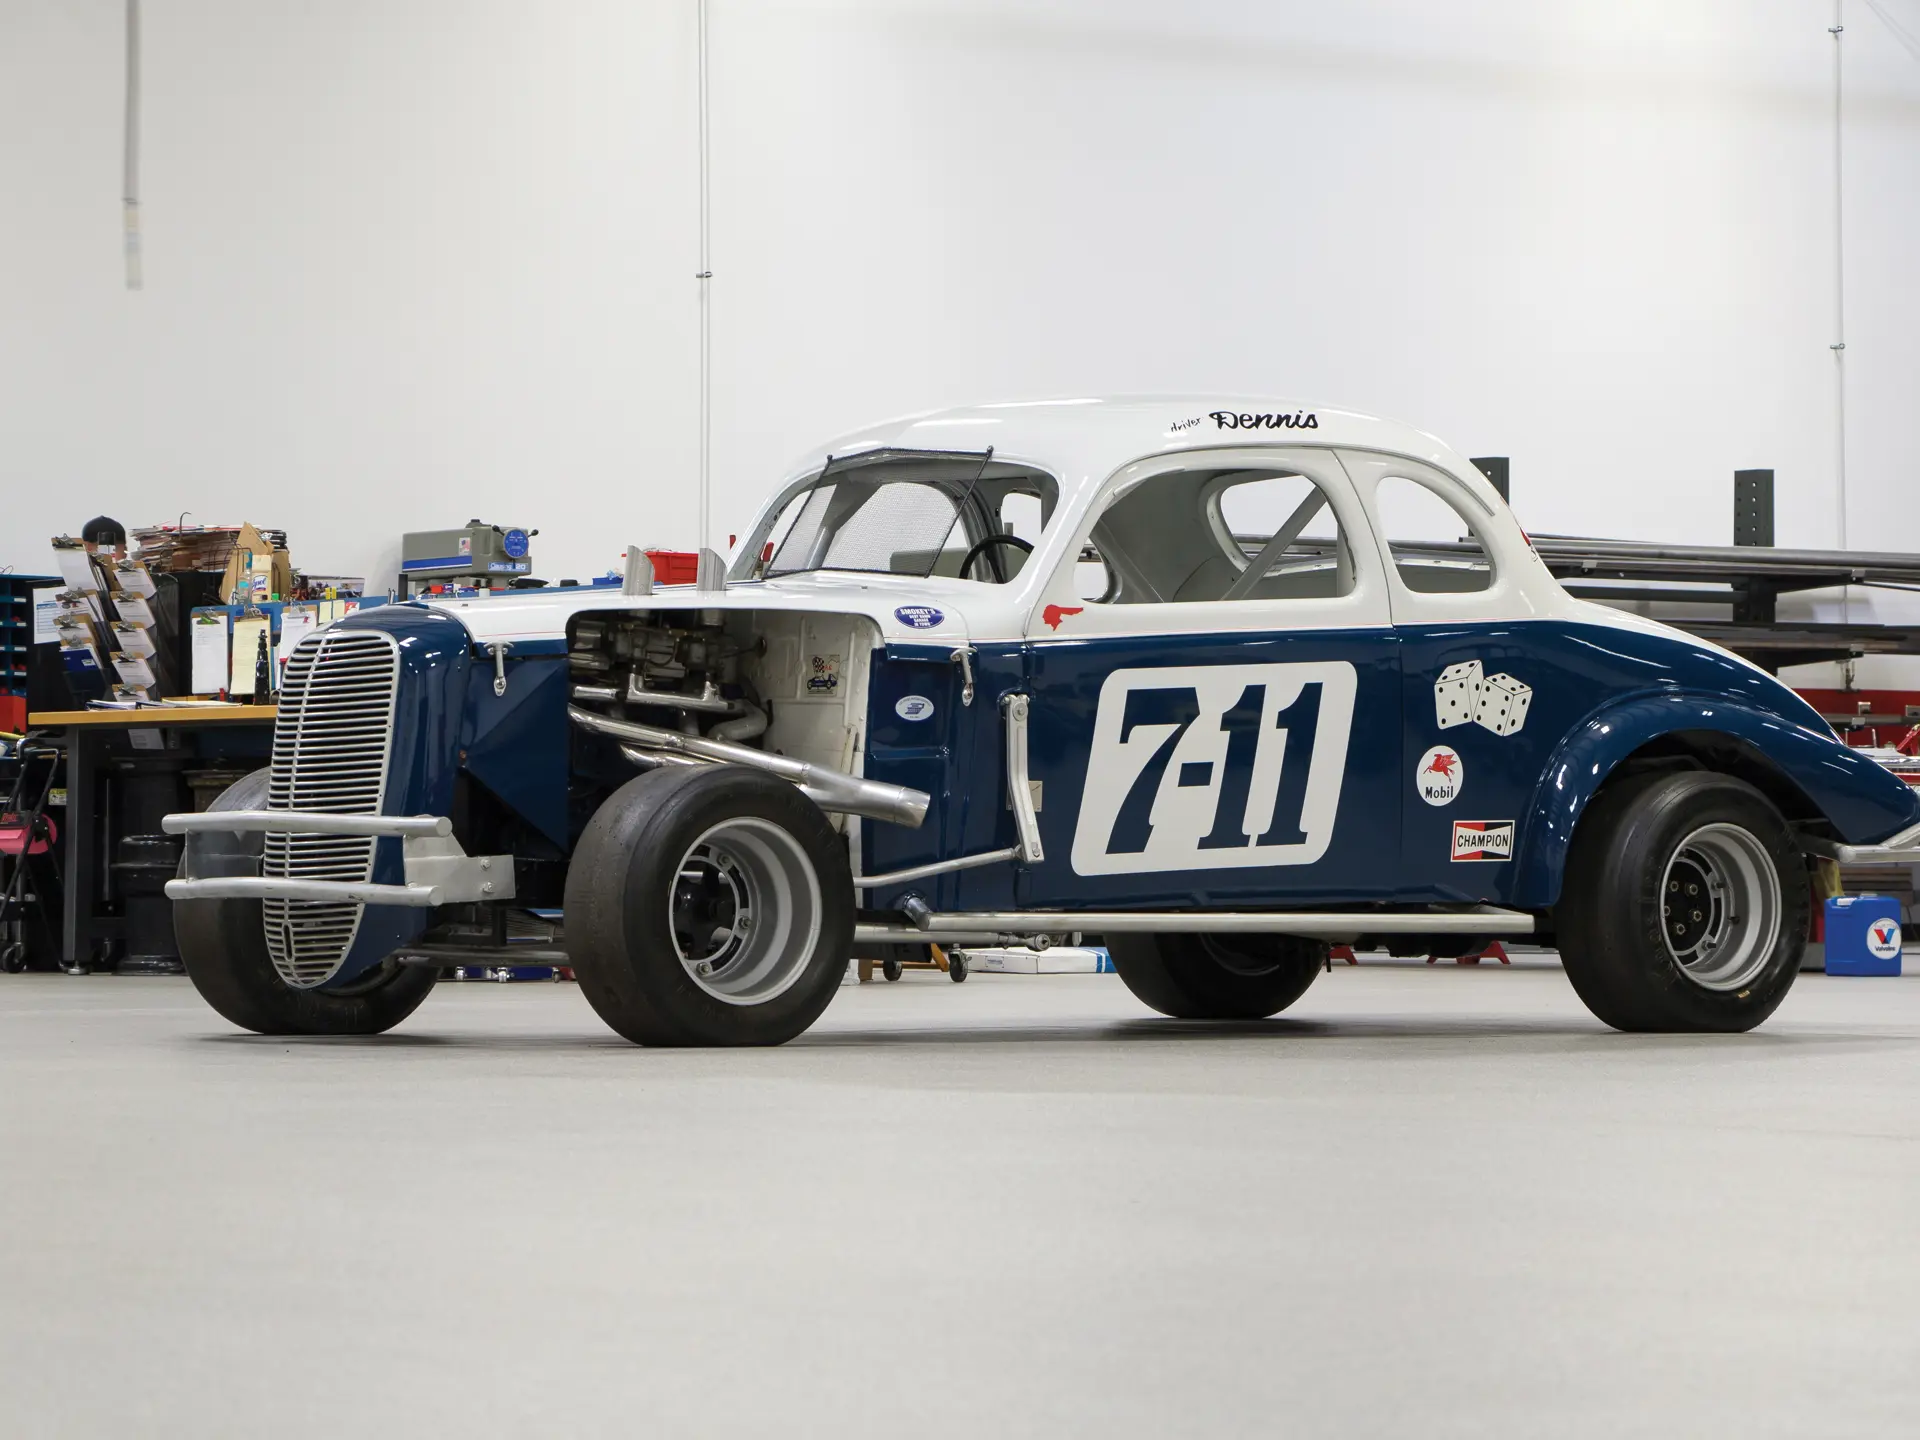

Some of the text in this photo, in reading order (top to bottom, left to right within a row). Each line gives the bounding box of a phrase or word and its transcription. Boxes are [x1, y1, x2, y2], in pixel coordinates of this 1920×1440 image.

[1170, 409, 1319, 433] driver Dennis
[1105, 682, 1324, 855] 7-11
[1425, 786, 1454, 799] Mobil
[1457, 834, 1509, 848] CHAMPION
